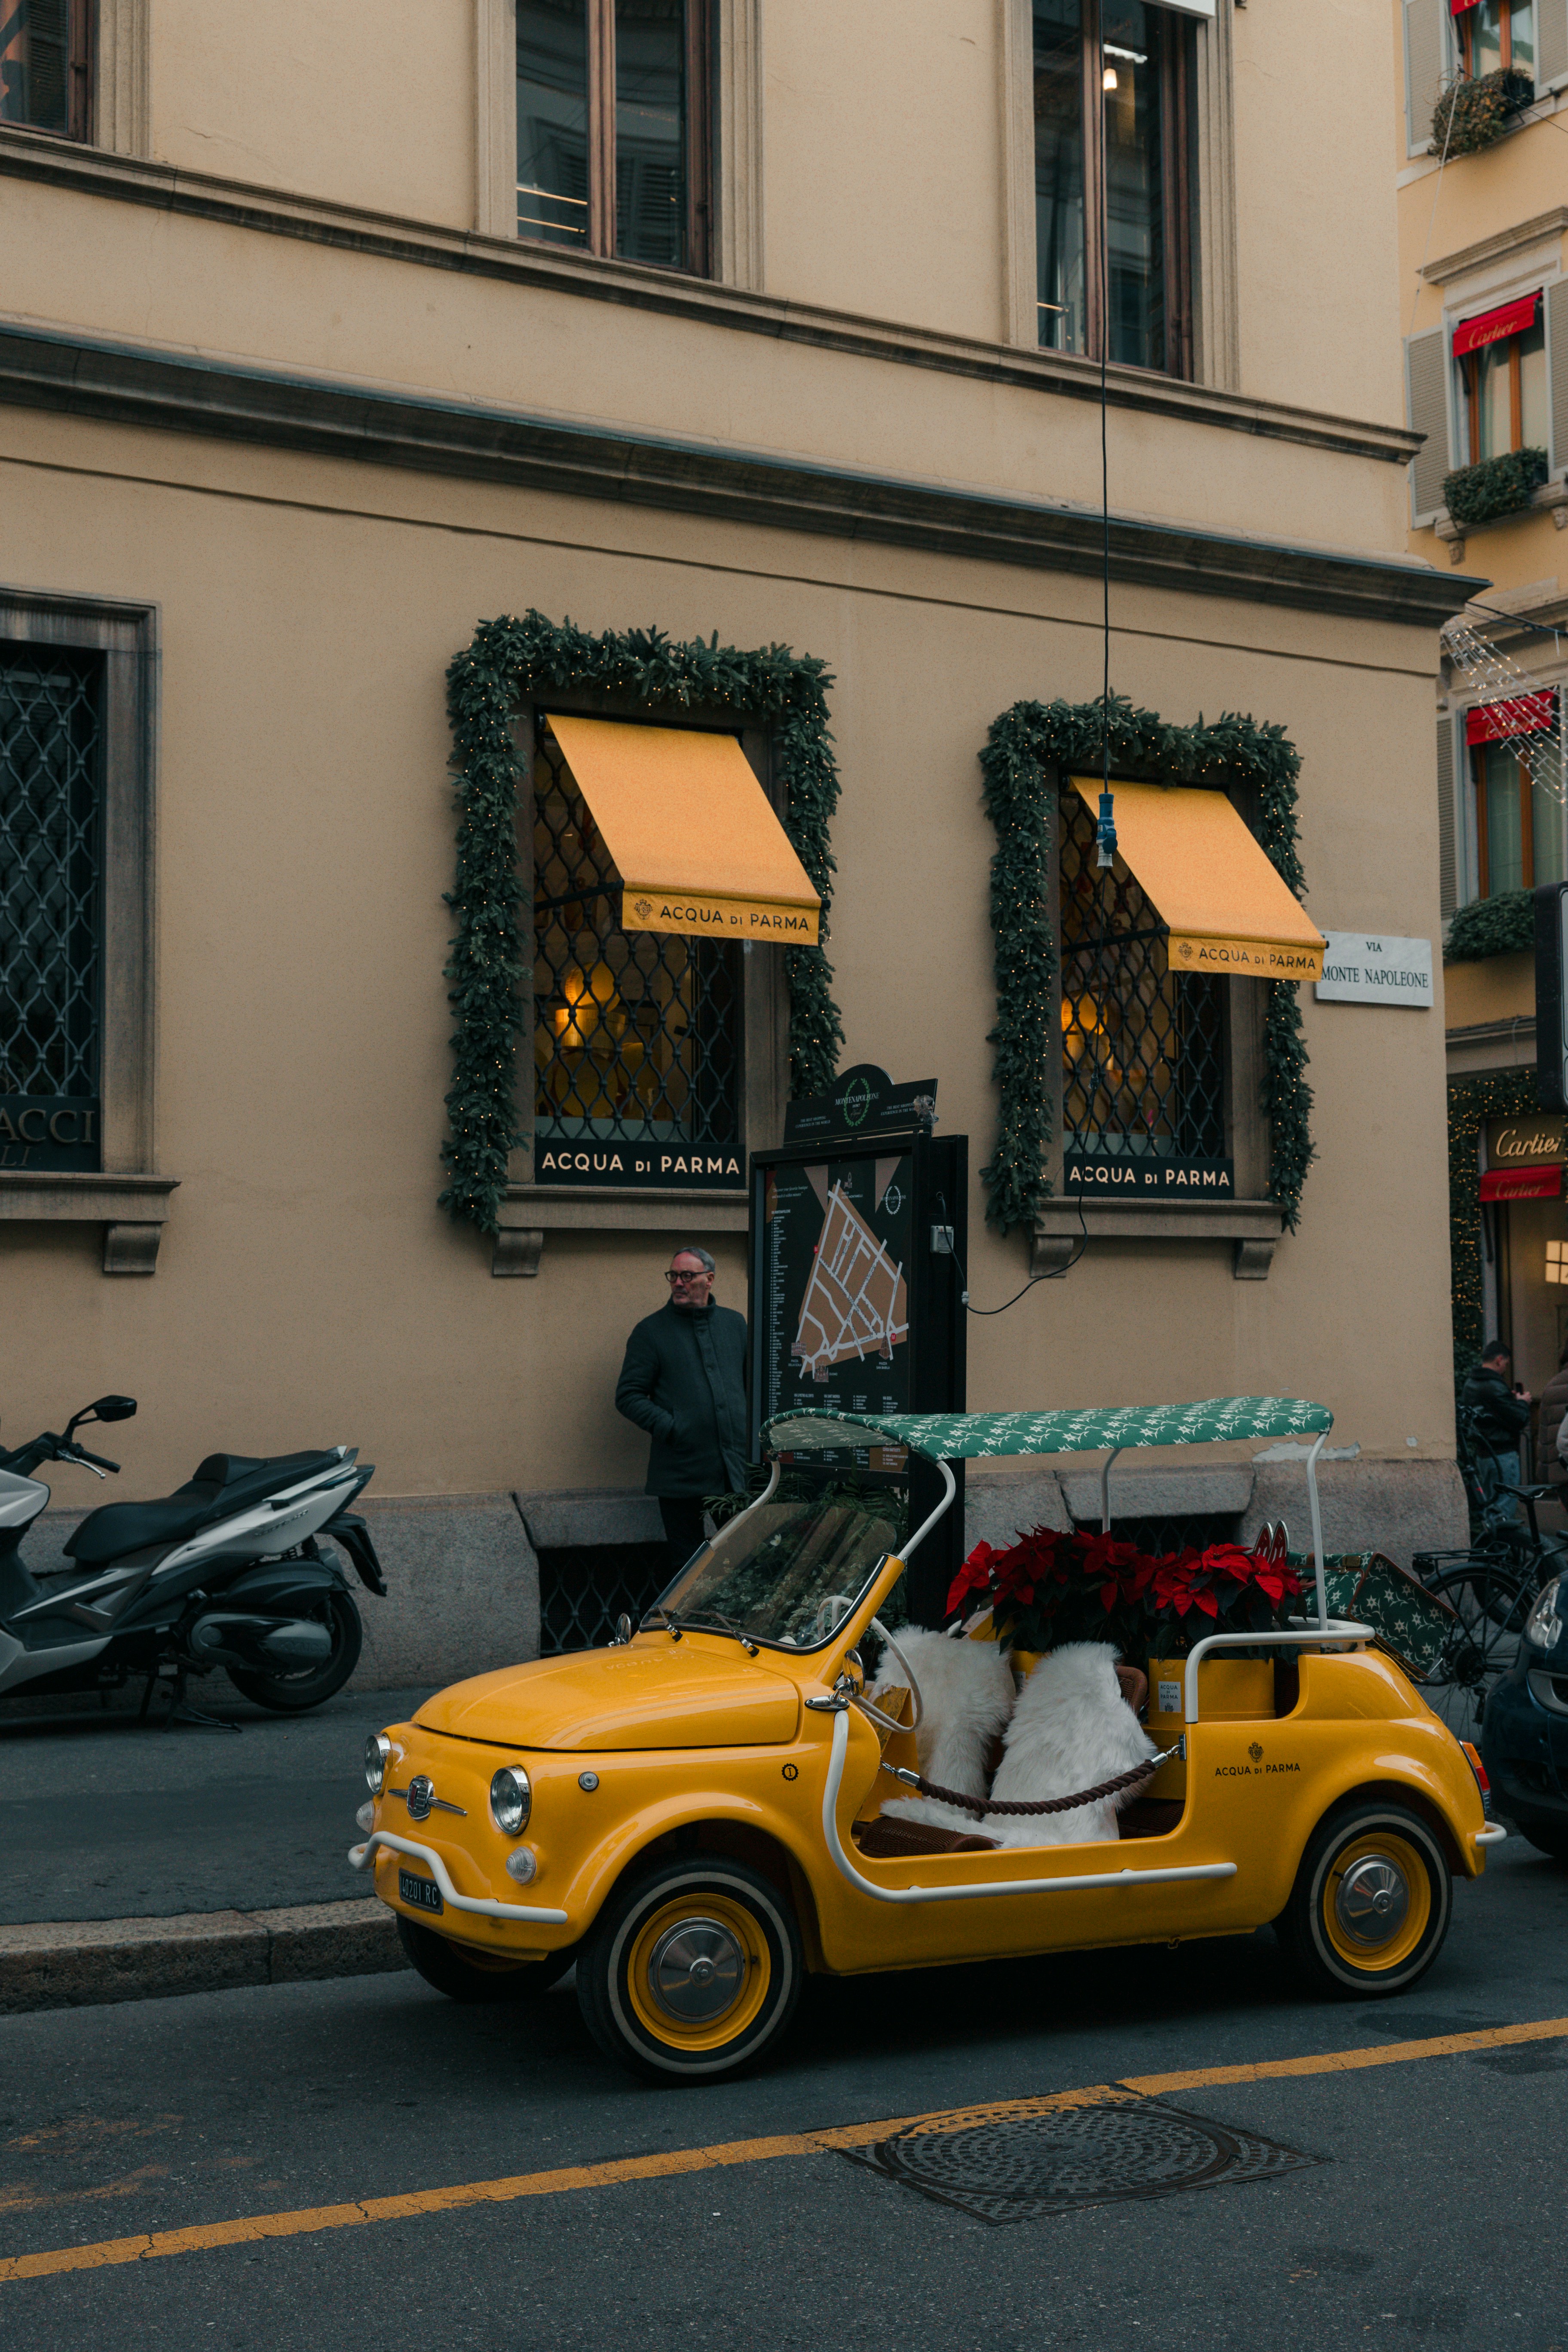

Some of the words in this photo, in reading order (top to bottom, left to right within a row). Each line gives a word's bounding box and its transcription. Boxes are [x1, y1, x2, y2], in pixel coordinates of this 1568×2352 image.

[660, 905, 723, 923] ACQUA
[731, 916, 742, 925] DI
[750, 913, 808, 931] PARMA
[1366, 942, 1382, 952] VIA
[1199, 948, 1250, 963] ACQUA
[1270, 954, 1315, 969] PARMA
[1322, 966, 1360, 983] MONTE
[1364, 968, 1428, 988] NAPOLEONE
[1496, 1129, 1561, 1158] Cartier
[542, 1152, 624, 1172] ACQUA
[635, 1161, 650, 1172] DI
[661, 1156, 740, 1174] PARMA
[1069, 1166, 1136, 1183] ACQUA
[1145, 1173, 1158, 1184] DI
[1166, 1169, 1230, 1186] PARMA
[1215, 1766, 1251, 1776] ACQUA
[1266, 1763, 1301, 1773] PARMA
[426, 1884, 437, 1905] RC
